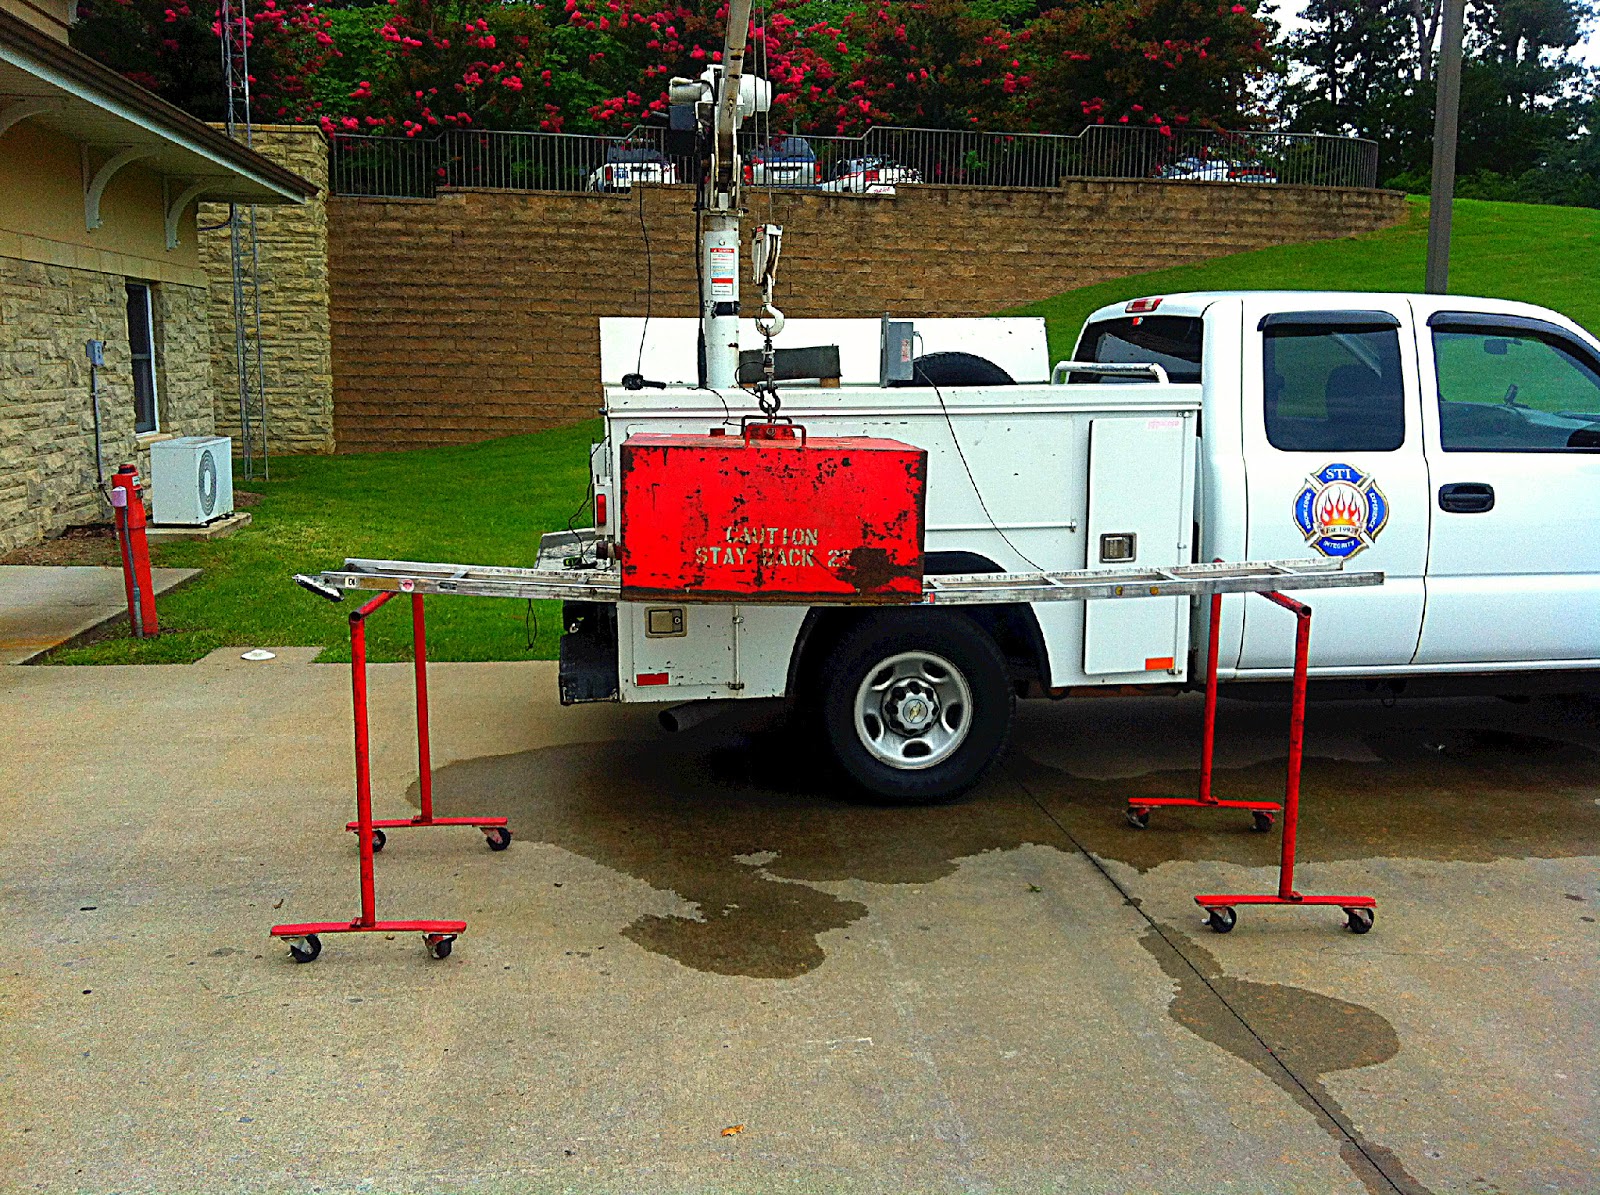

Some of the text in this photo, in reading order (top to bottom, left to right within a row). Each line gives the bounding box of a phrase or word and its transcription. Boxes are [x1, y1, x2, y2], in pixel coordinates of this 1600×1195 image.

[1326, 468, 1351, 479] STI
[726, 526, 818, 545] CAUTION
[1323, 540, 1355, 549] INTEGRITY
[696, 547, 747, 565] STAY
[761, 548, 815, 567] BACK
